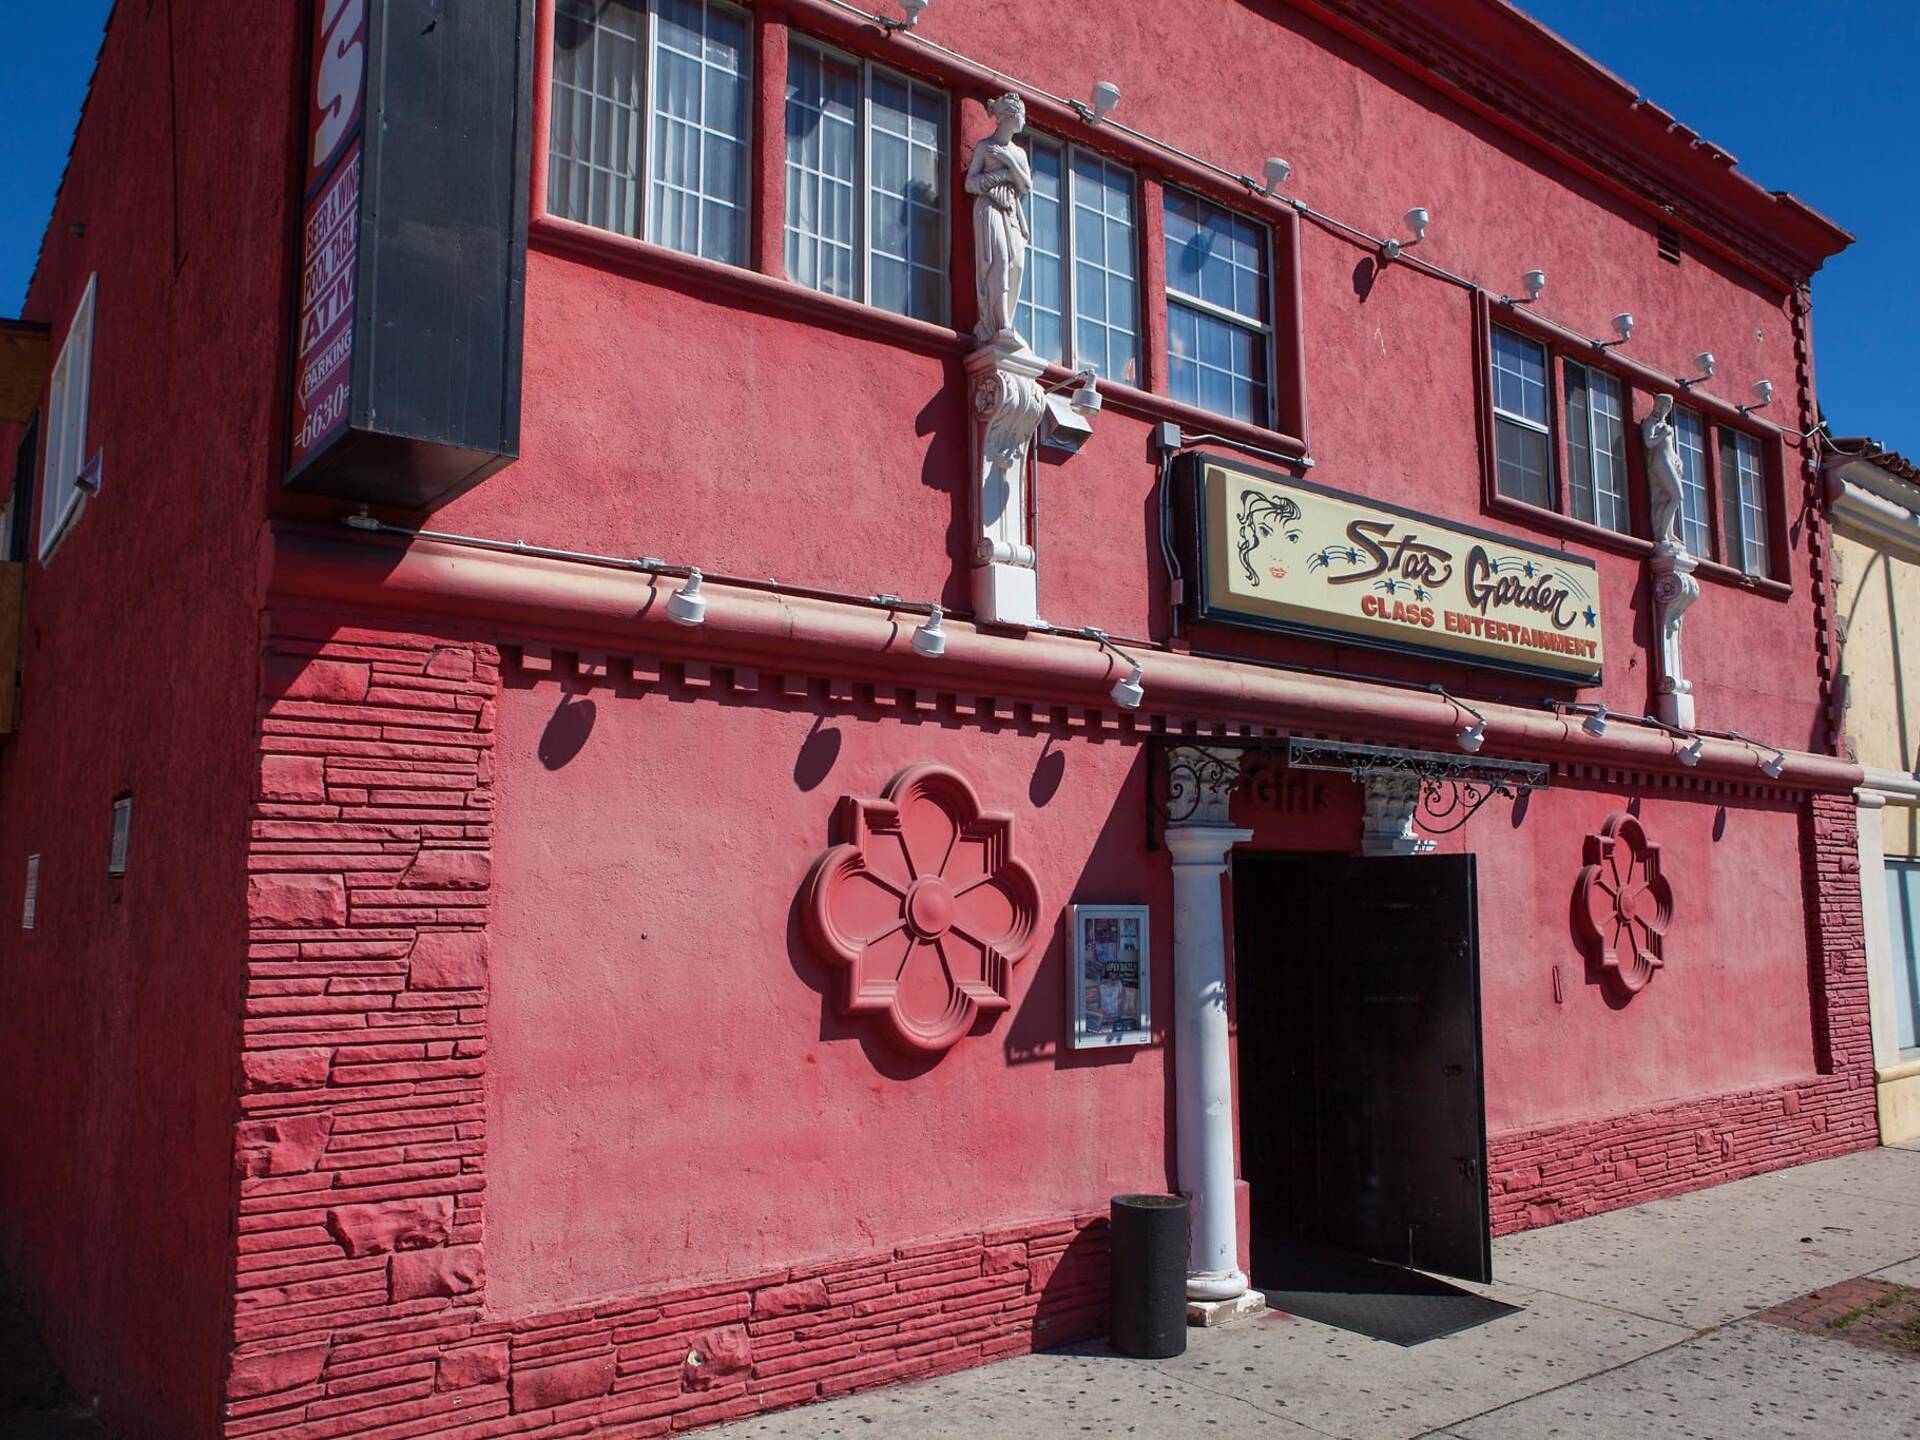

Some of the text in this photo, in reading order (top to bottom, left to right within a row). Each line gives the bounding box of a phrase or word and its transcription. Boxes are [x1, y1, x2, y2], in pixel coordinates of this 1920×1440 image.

[307, 207, 329, 258] BEER
[330, 191, 337, 225] &
[304, 251, 329, 300] POOL
[301, 272, 355, 353] ATM
[303, 327, 353, 392] PARKING
[1328, 519, 1577, 630] Star Garden
[1361, 594, 1598, 659] CLASS ENTERTAINMENT
